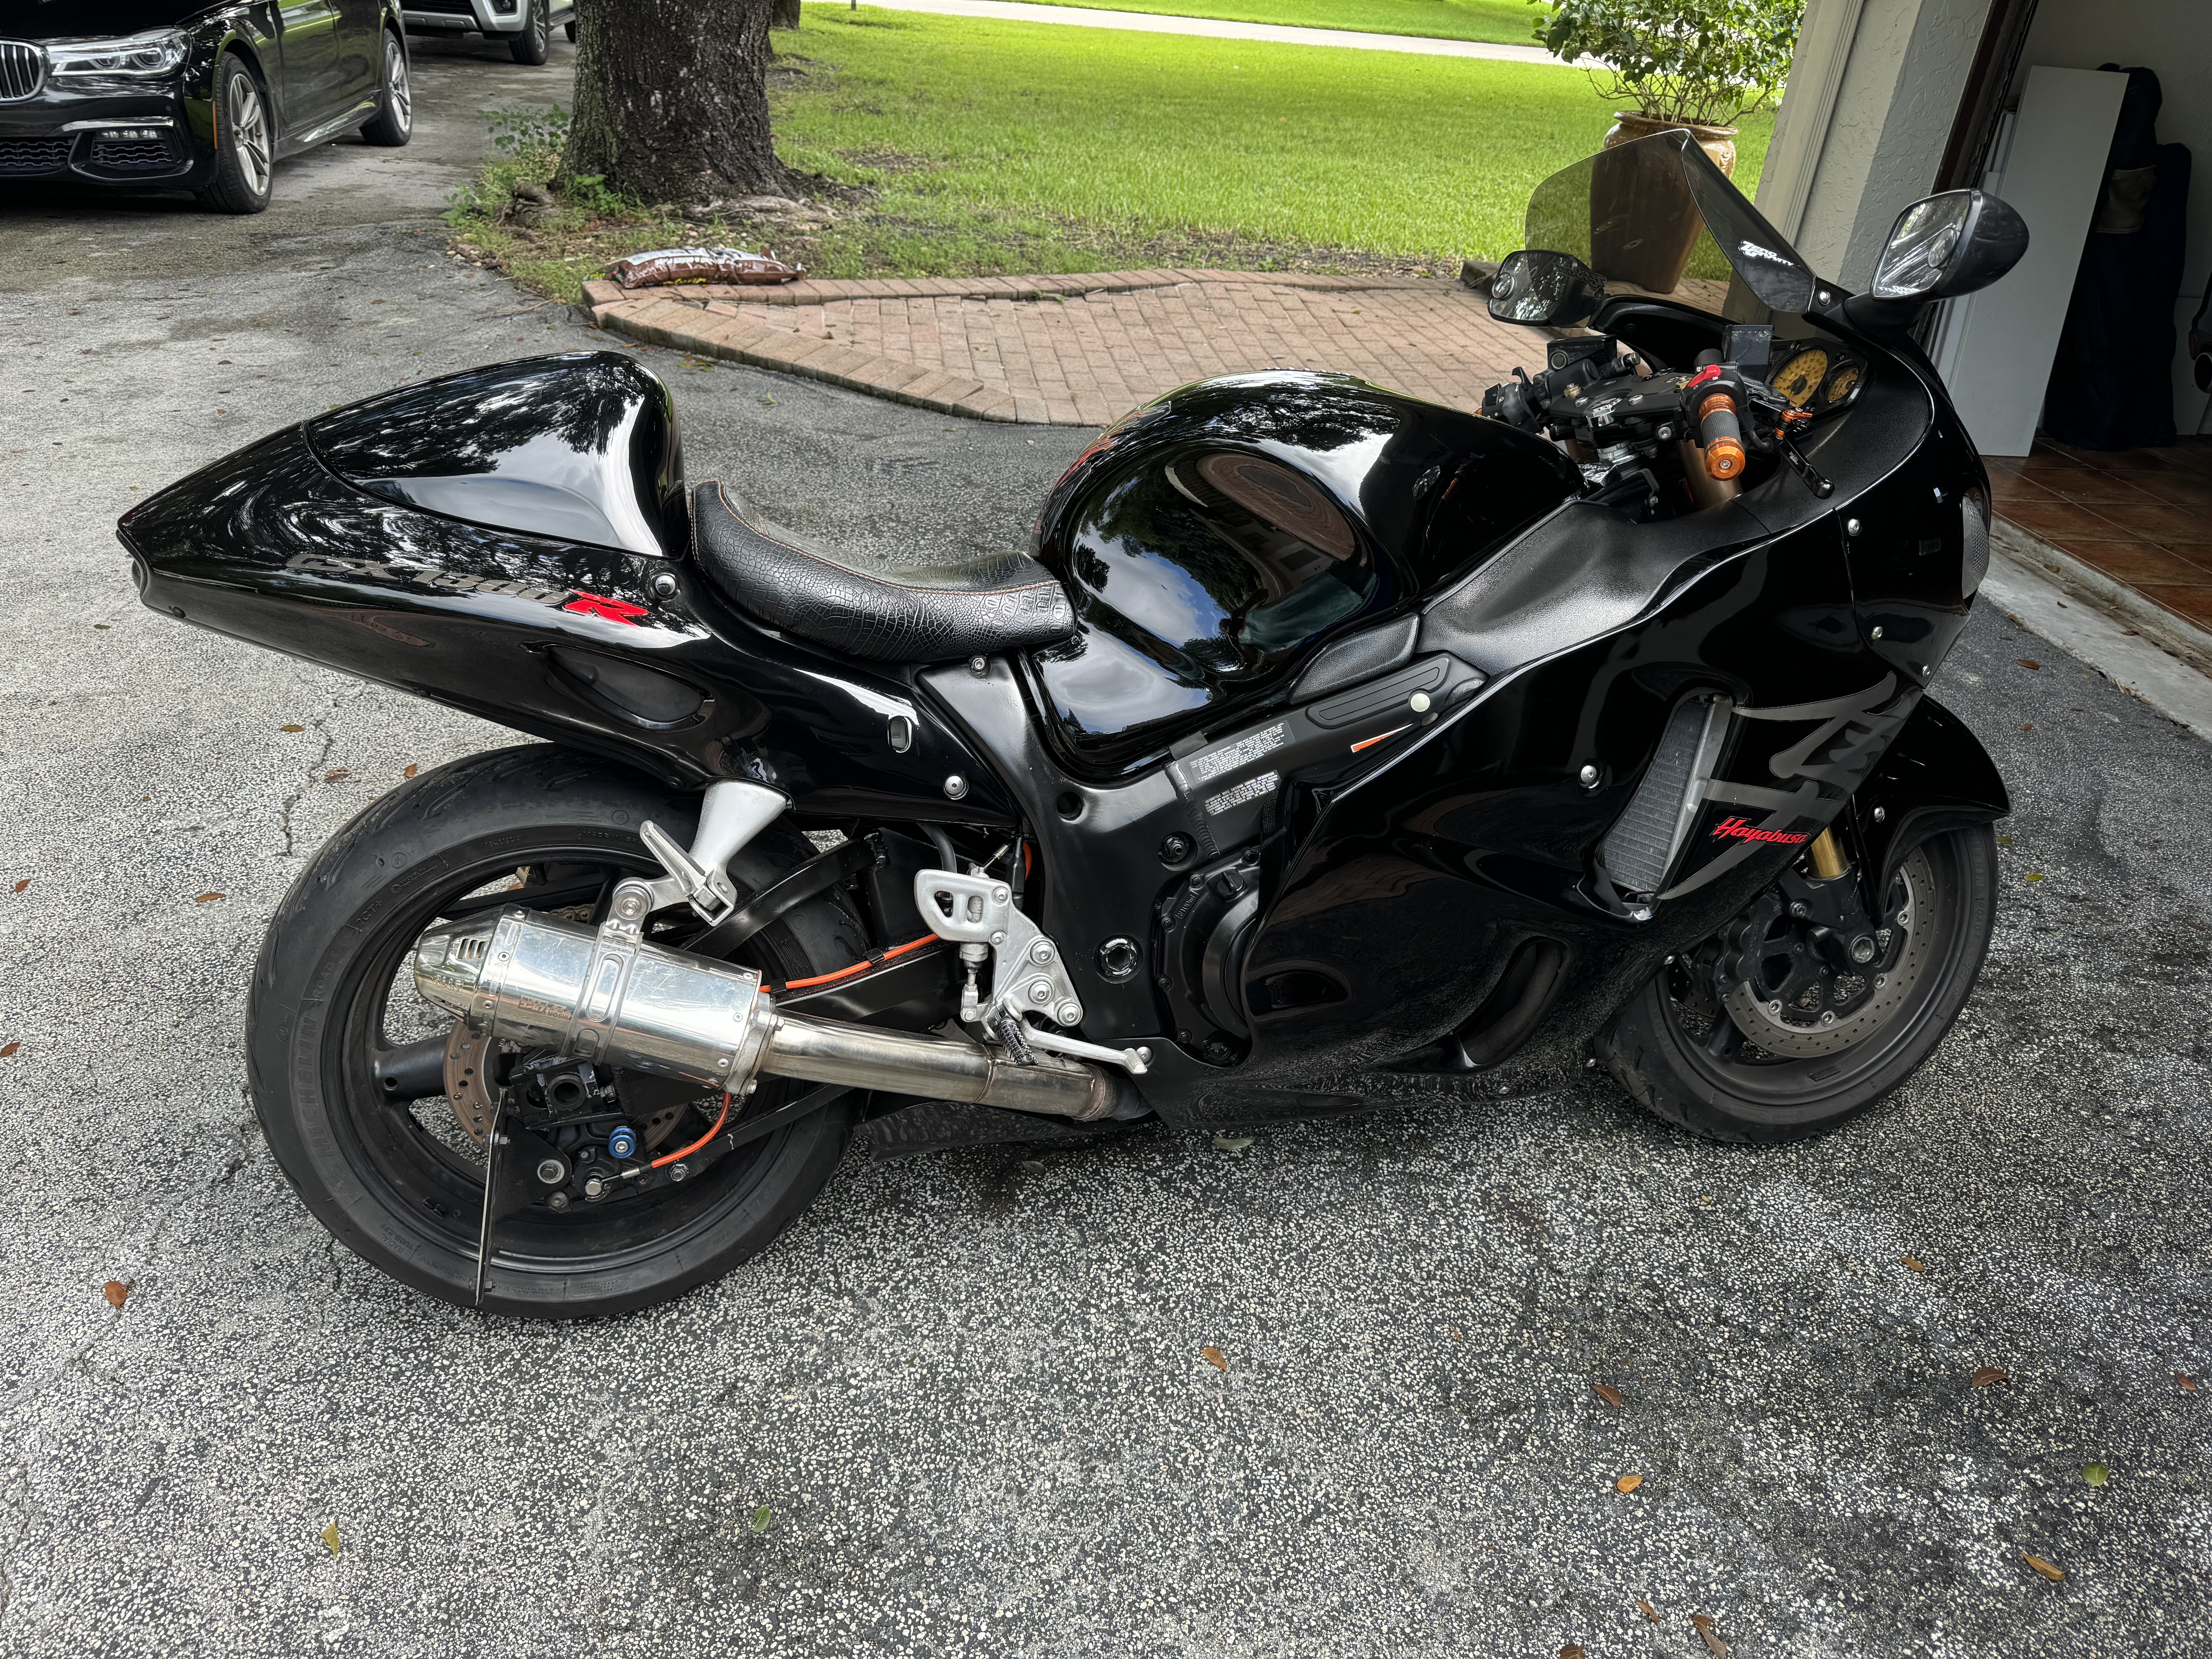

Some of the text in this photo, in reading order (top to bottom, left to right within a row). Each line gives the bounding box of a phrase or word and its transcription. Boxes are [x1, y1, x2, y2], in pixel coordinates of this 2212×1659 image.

[1740, 240, 1777, 256] ZERO
[1743, 250, 1794, 266] GRAVITY
[285, 553, 649, 627] GSX1300R
[1712, 817, 1807, 845] Hayabusa
[311, 961, 334, 998] ROAD
[298, 1015, 335, 1158] MICHELIN
[379, 1233, 405, 1254] RADIAL
[380, 1223, 413, 1250] TUBELESS
